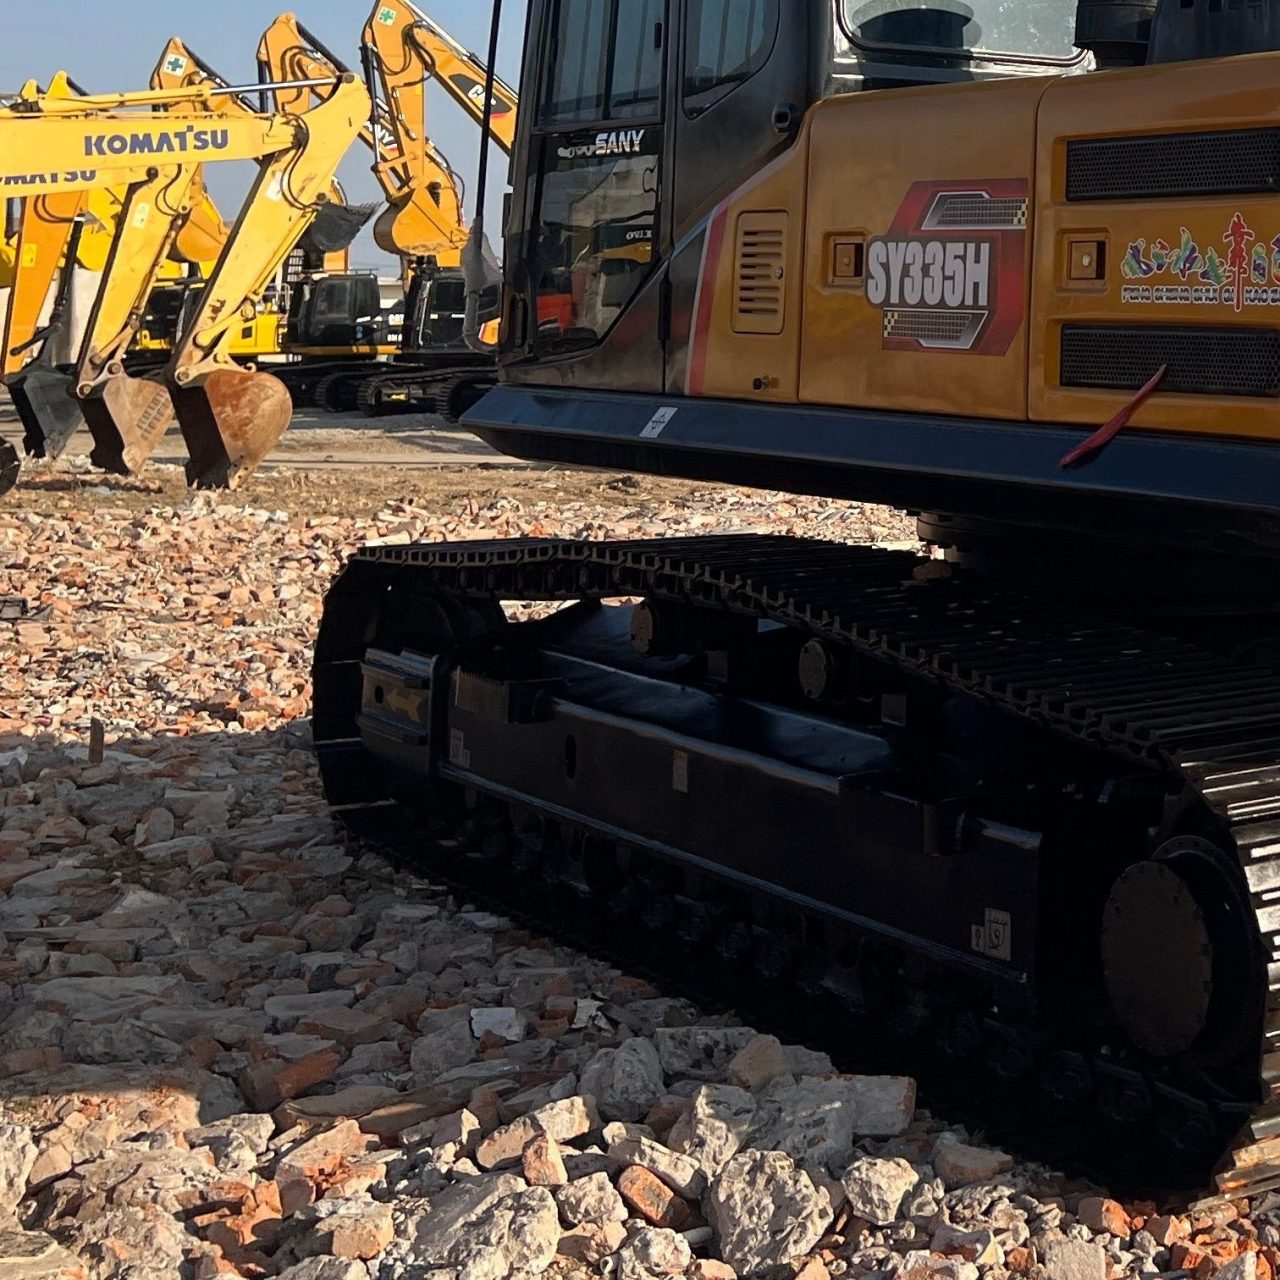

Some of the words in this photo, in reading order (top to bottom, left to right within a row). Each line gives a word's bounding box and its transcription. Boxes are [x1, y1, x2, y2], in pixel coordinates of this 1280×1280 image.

[84, 125, 228, 156] KOMATSU
[595, 129, 645, 155] SANY
[867, 240, 990, 307] SY335H
